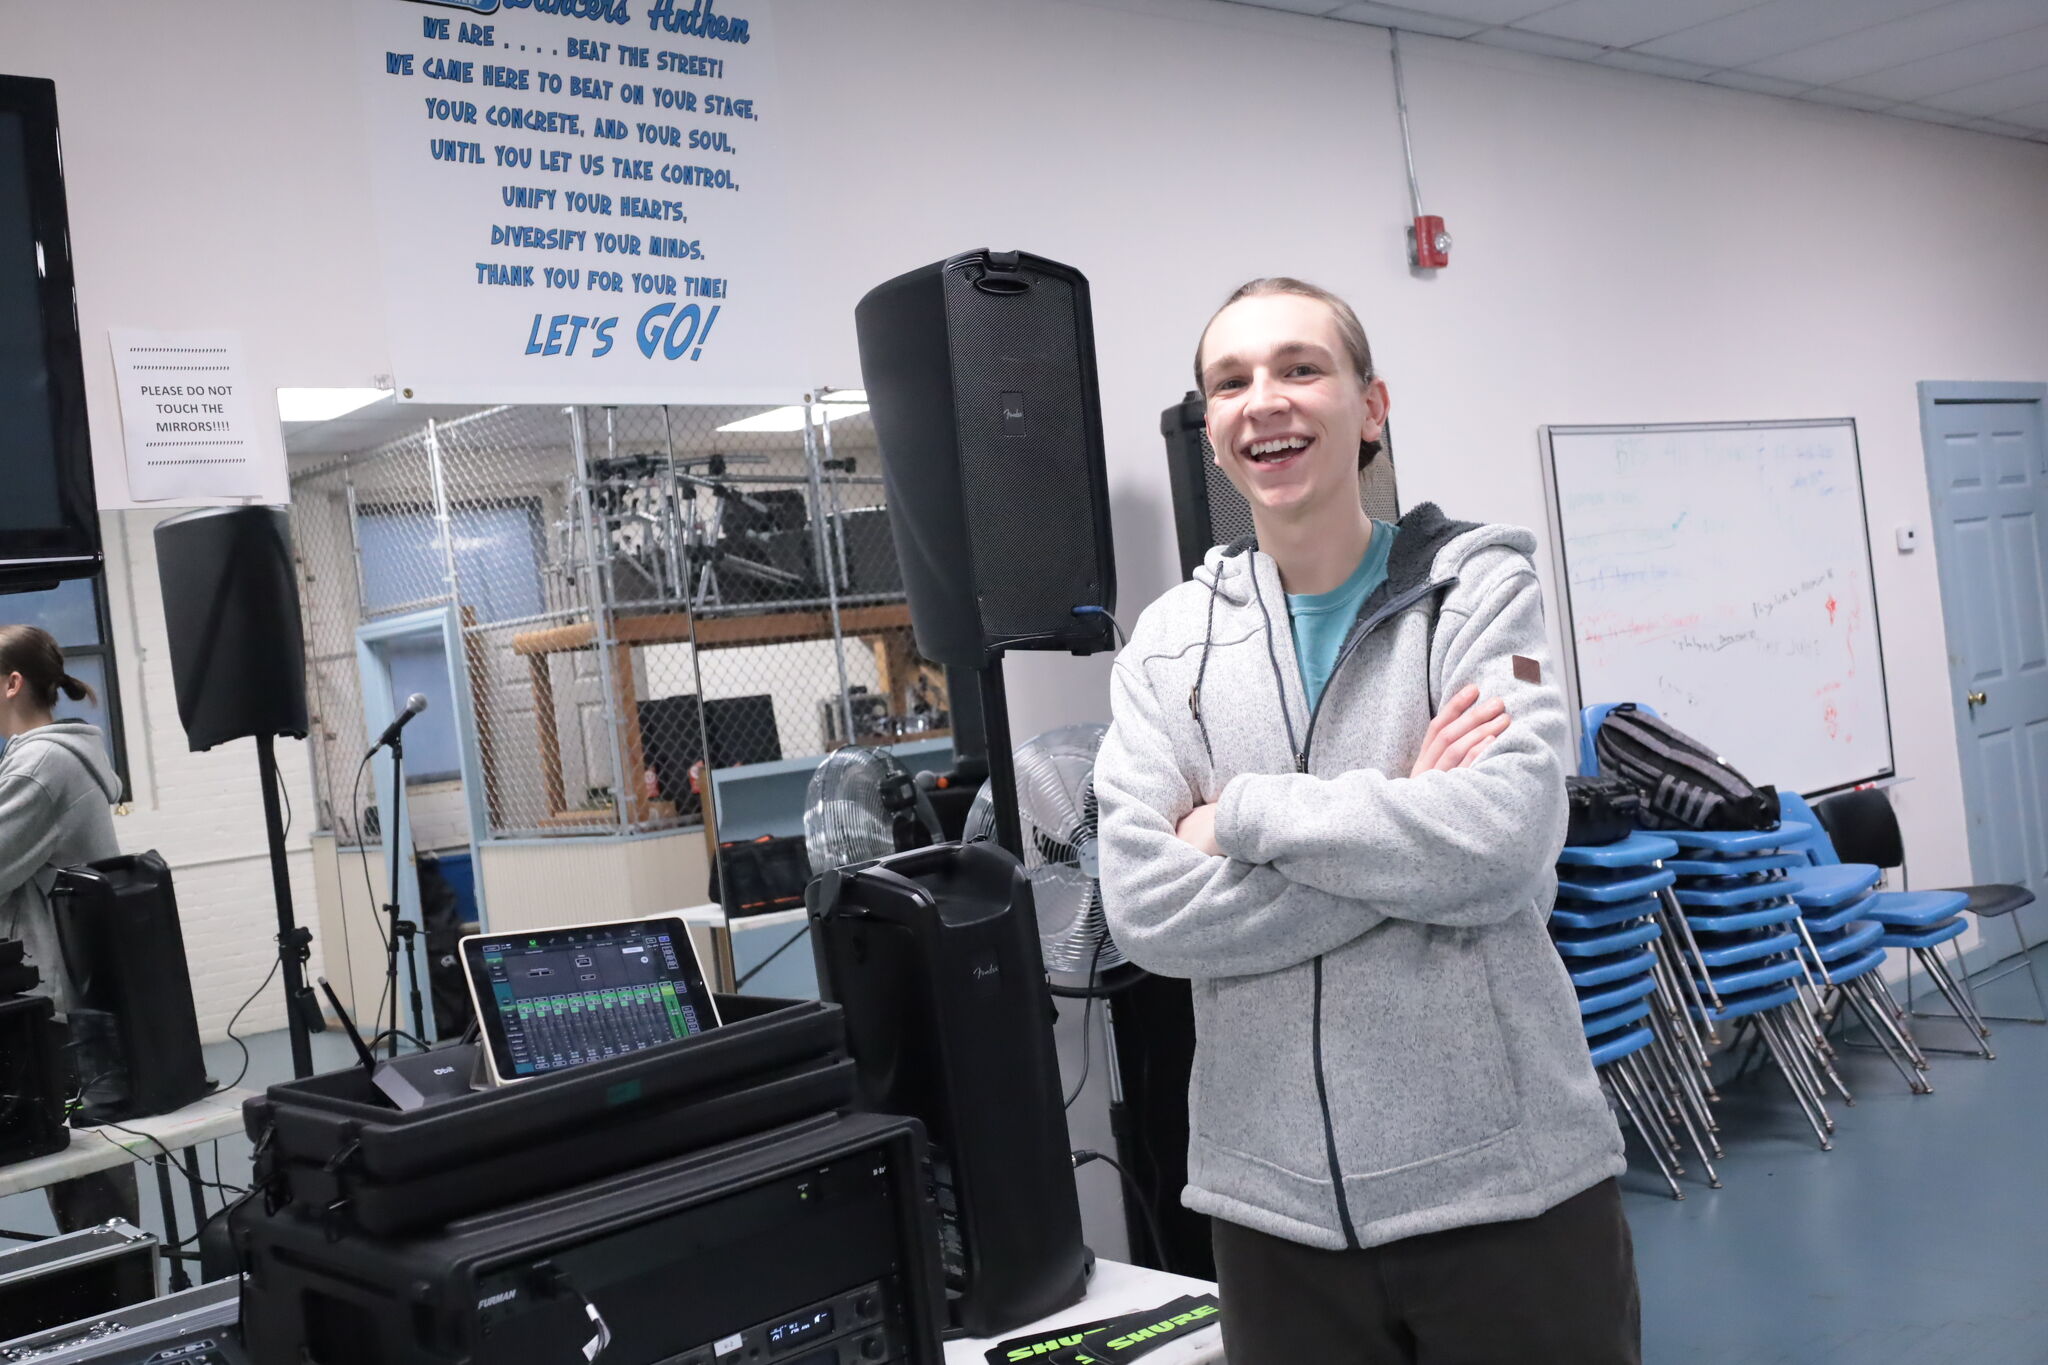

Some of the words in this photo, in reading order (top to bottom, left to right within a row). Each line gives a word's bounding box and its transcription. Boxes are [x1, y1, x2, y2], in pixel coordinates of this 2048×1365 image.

[647, 0, 750, 44] Anthem
[423, 16, 450, 40] WE
[458, 22, 495, 46] ARE
[567, 37, 611, 62] BEAT
[618, 44, 650, 68] THE
[656, 51, 724, 78] STREET!
[386, 52, 416, 75] WE
[422, 58, 476, 83] CAME
[482, 66, 529, 90] HERE
[537, 71, 564, 95] TO
[570, 75, 614, 100] BEAT
[620, 84, 645, 104] ON
[652, 88, 697, 112] YOUR
[703, 95, 757, 120] STAGE,
[425, 98, 478, 124] YOUR
[486, 106, 584, 136] CONCRETE,
[593, 118, 630, 140] AND
[636, 123, 683, 147] YOUR
[688, 129, 736, 154] SOUL,
[431, 139, 487, 164] UNTIL
[495, 146, 533, 168] YOU
[540, 149, 573, 172] LET
[579, 155, 606, 176] US
[611, 158, 656, 182] TAKE
[659, 164, 740, 191] CONTROL,
[501, 187, 558, 209] UNIFY
[563, 192, 613, 216] YOUR
[620, 196, 688, 222] HEARTS,
[491, 224, 587, 252] DIVERSIFY
[594, 232, 642, 255] YOUR
[648, 236, 704, 260] MINDS.
[475, 264, 536, 288] THANK
[543, 268, 581, 288] YOU
[587, 271, 624, 293] FOR
[631, 274, 678, 296] YOUR
[683, 277, 729, 298] TIME!
[524, 314, 621, 358] LET'S
[636, 301, 721, 360] GO!
[141, 386, 183, 395] PLEASE
[187, 386, 204, 395] DO
[208, 385, 233, 396] NOT
[156, 404, 198, 413] TOUCH
[202, 404, 223, 413] THE
[155, 421, 230, 433] MIRRORS!!!!
[478, 1289, 517, 1310] FURMAN
[1107, 1305, 1220, 1350] SHURE
